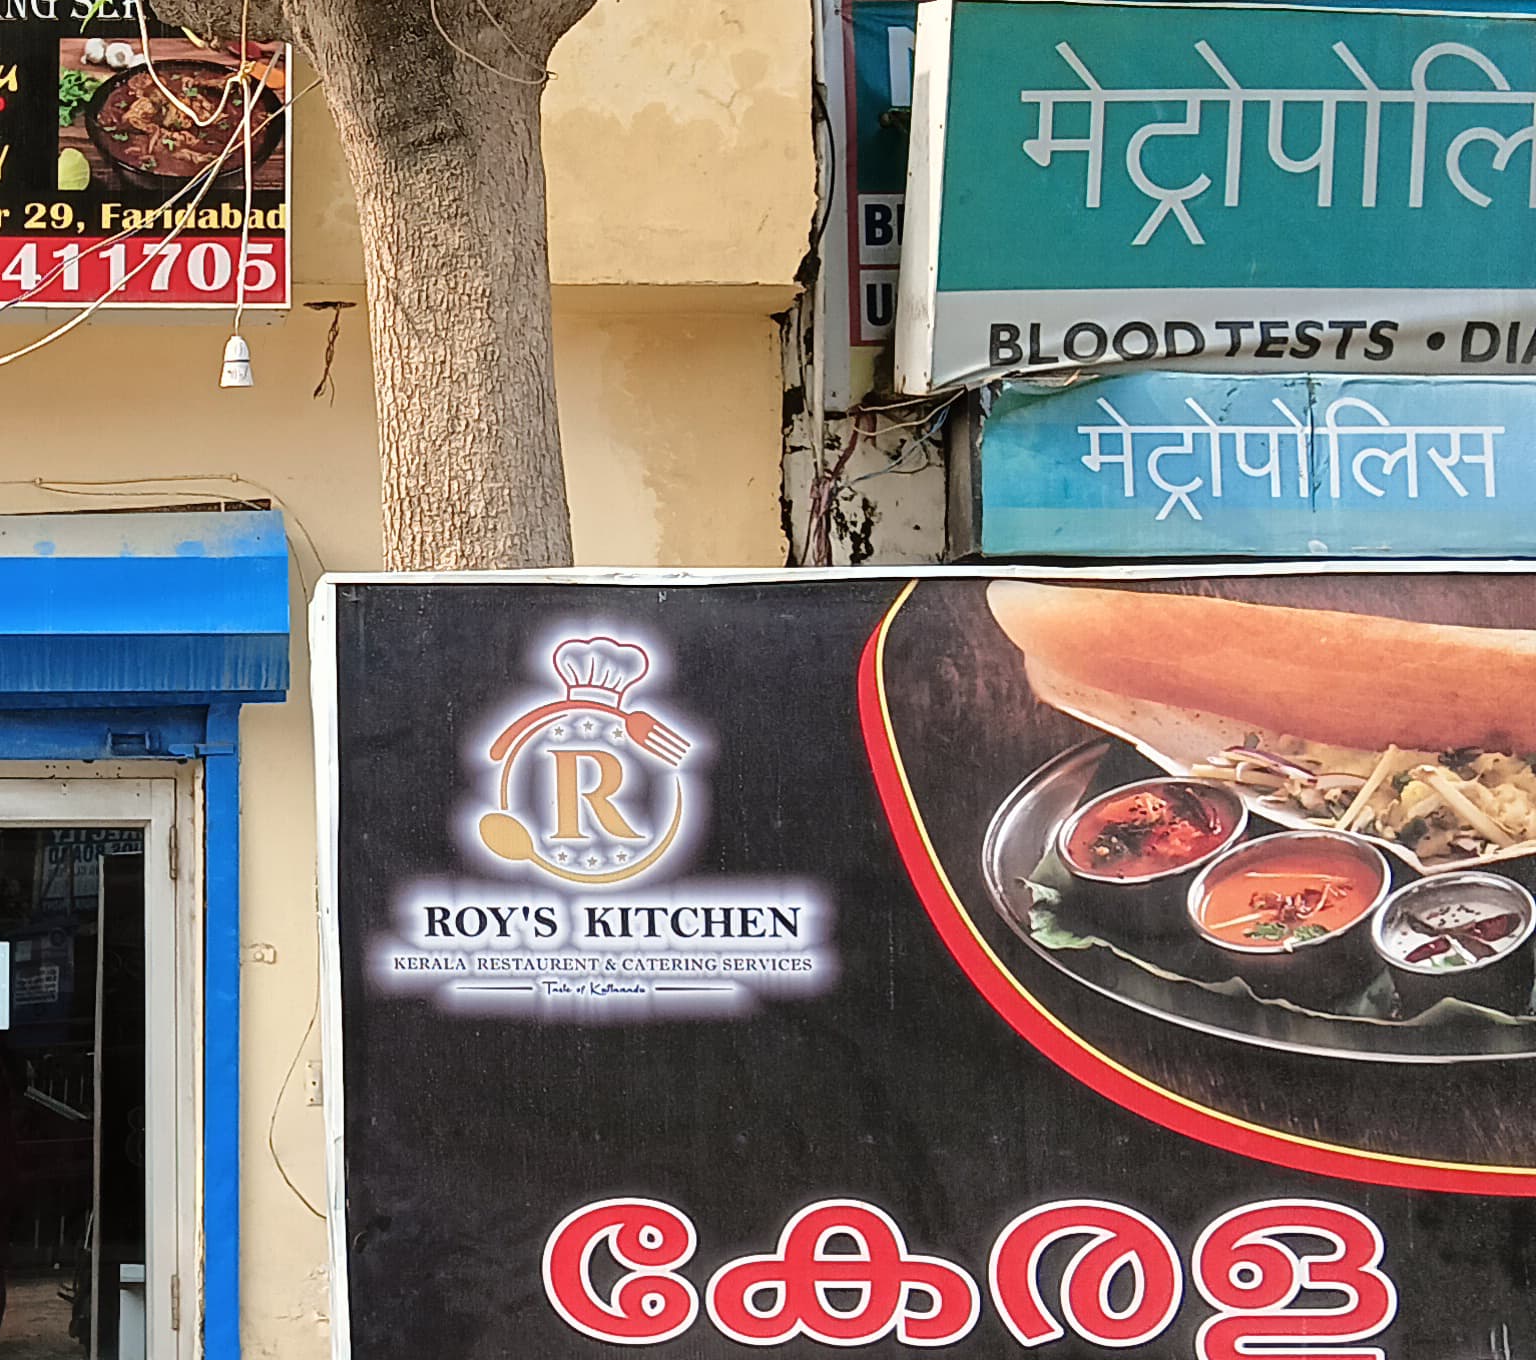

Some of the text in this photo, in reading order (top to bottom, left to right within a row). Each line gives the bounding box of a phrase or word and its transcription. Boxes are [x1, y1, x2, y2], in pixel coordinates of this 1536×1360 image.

[24, 203, 86, 233] 29,
[101, 203, 286, 230] Faridabad
[989, 321, 1205, 367] BLOOD
[1215, 319, 1398, 360] TESTS
[1077, 397, 1504, 521] मेट्रोपोलिस
[546, 748, 647, 839] R
[423, 906, 801, 939] ROY'S KITCHEN
[393, 957, 814, 972] KERALA RESTAURENT & CATERING SERVICES
